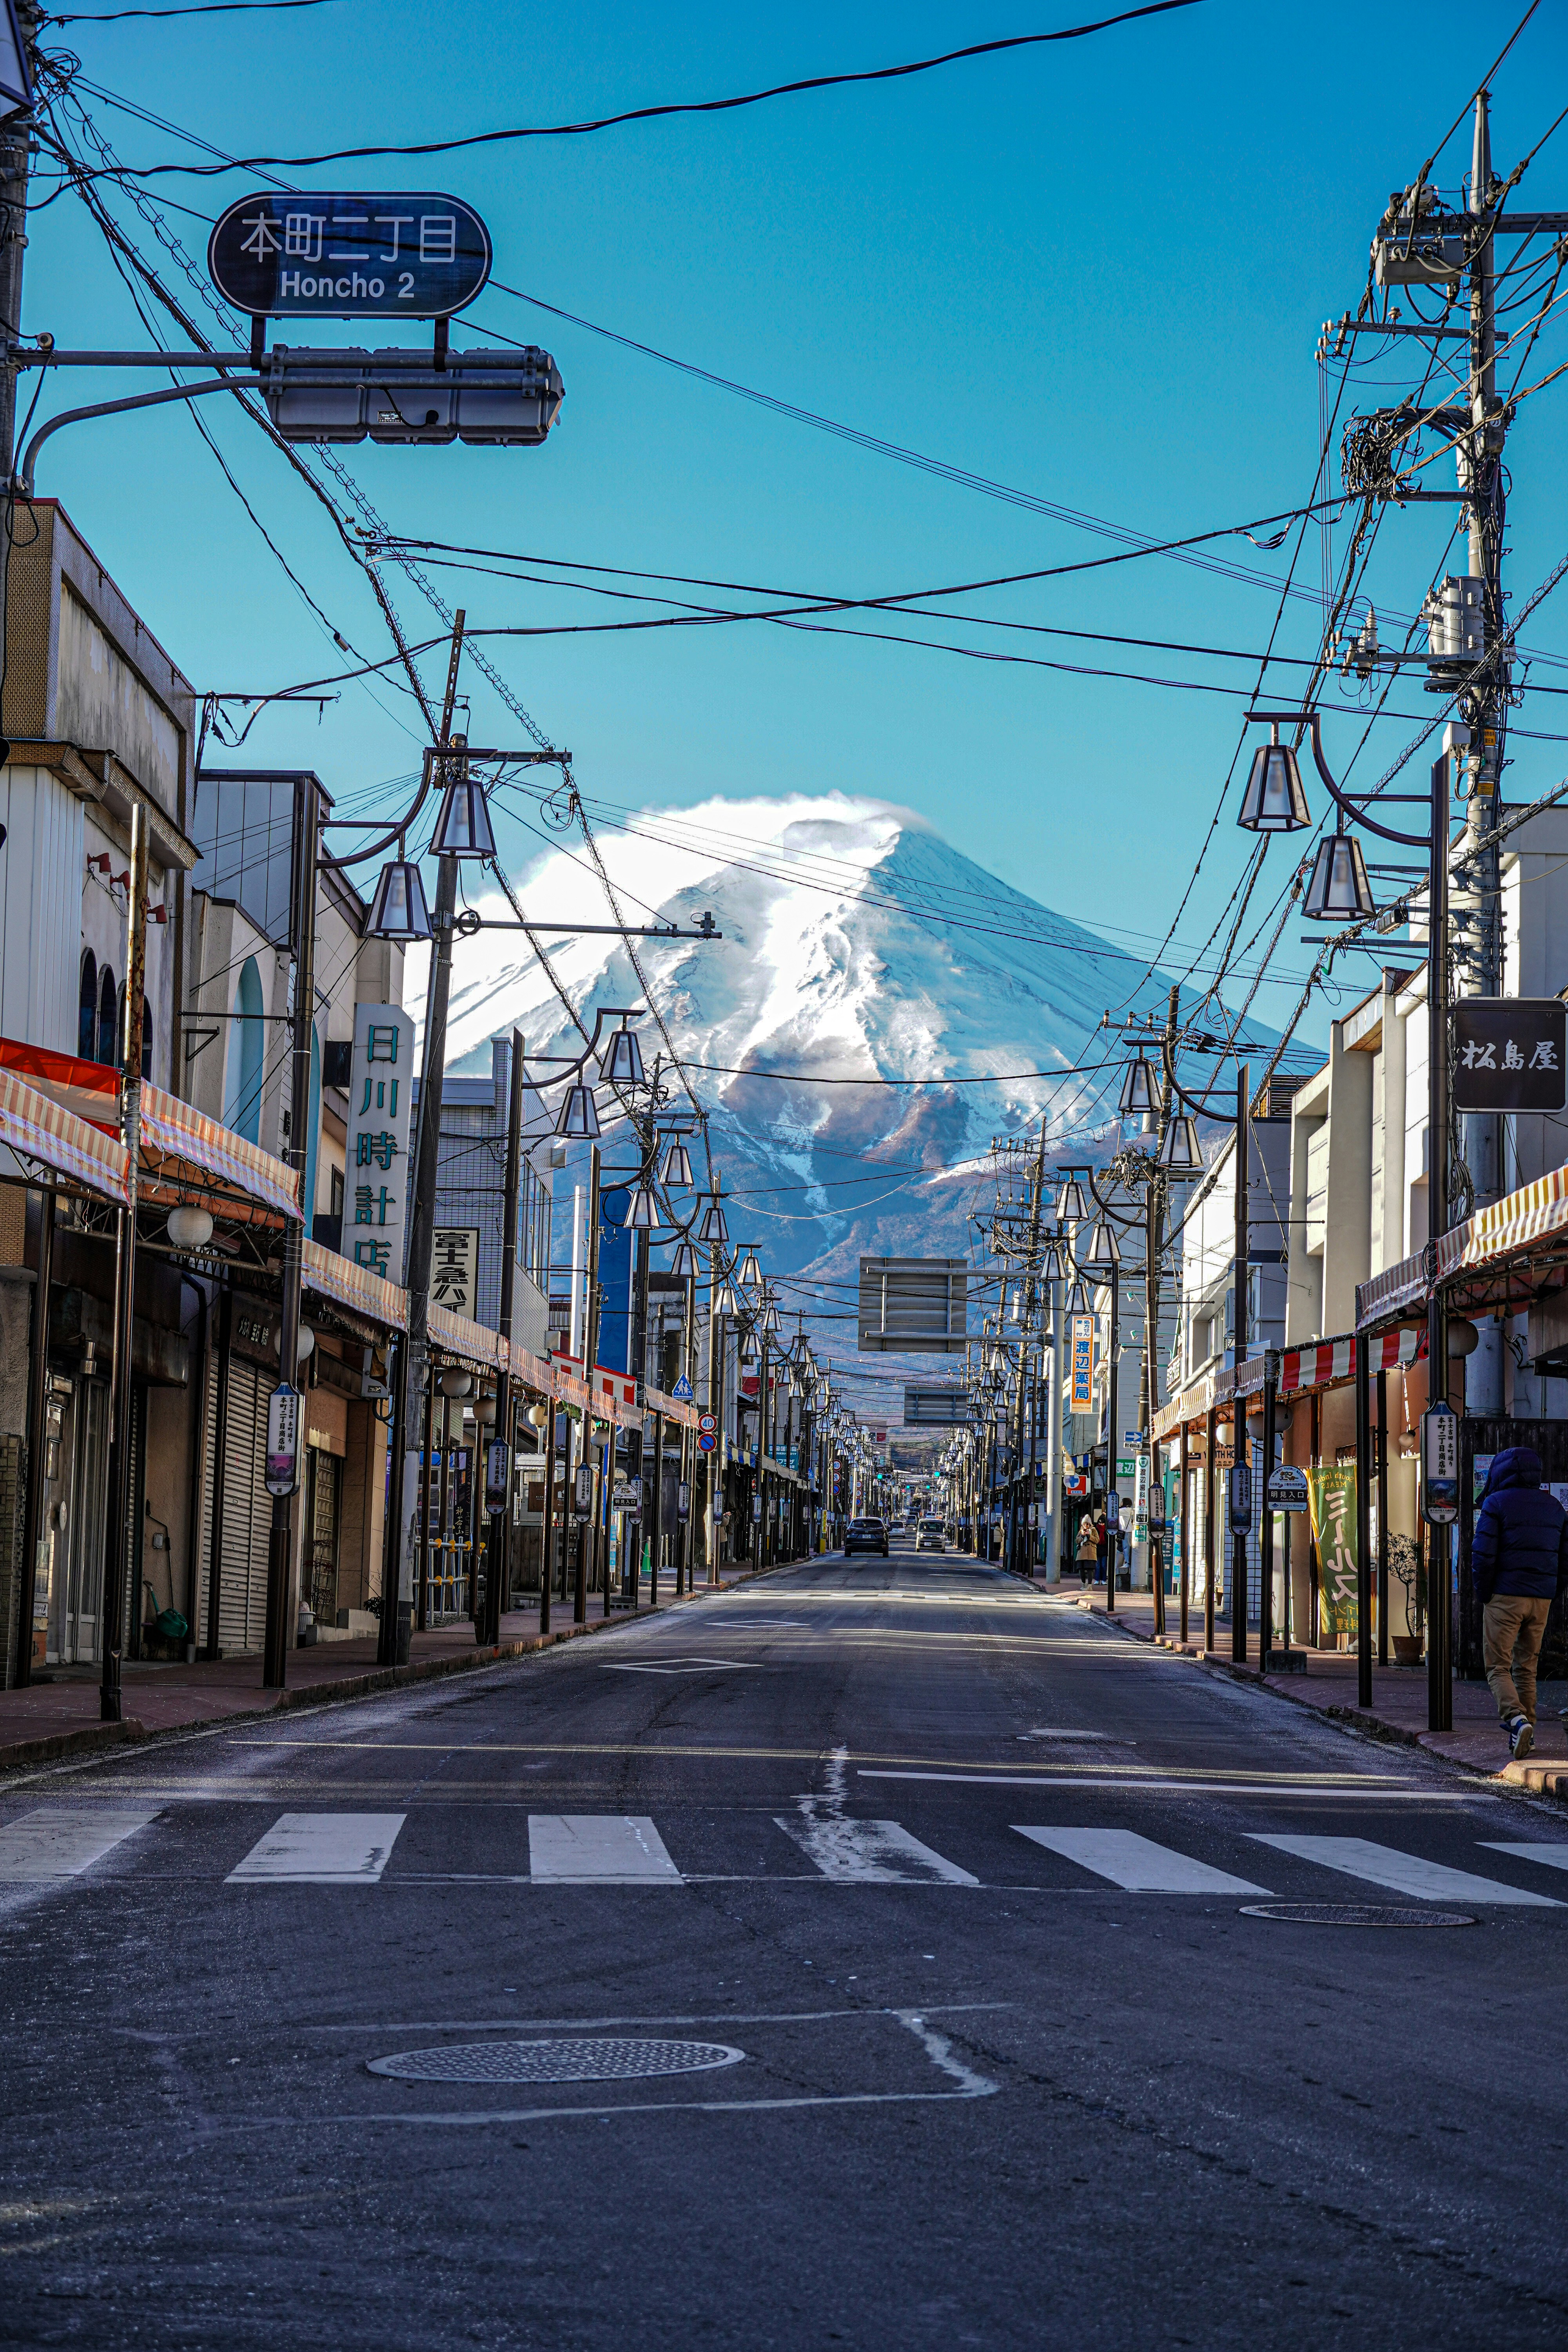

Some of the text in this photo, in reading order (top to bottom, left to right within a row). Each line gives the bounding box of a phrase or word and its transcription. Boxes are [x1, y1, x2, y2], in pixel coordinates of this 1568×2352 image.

[240, 212, 456, 263] 本町二丁目
[281, 272, 415, 298] Honcho 2
[1461, 1039, 1559, 1071] 松島屋
[355, 1025, 400, 1279] 日川時計店
[1075, 1341, 1090, 1399] 渡辺薬局
[278, 1396, 288, 1452] 本町二丁目商店街
